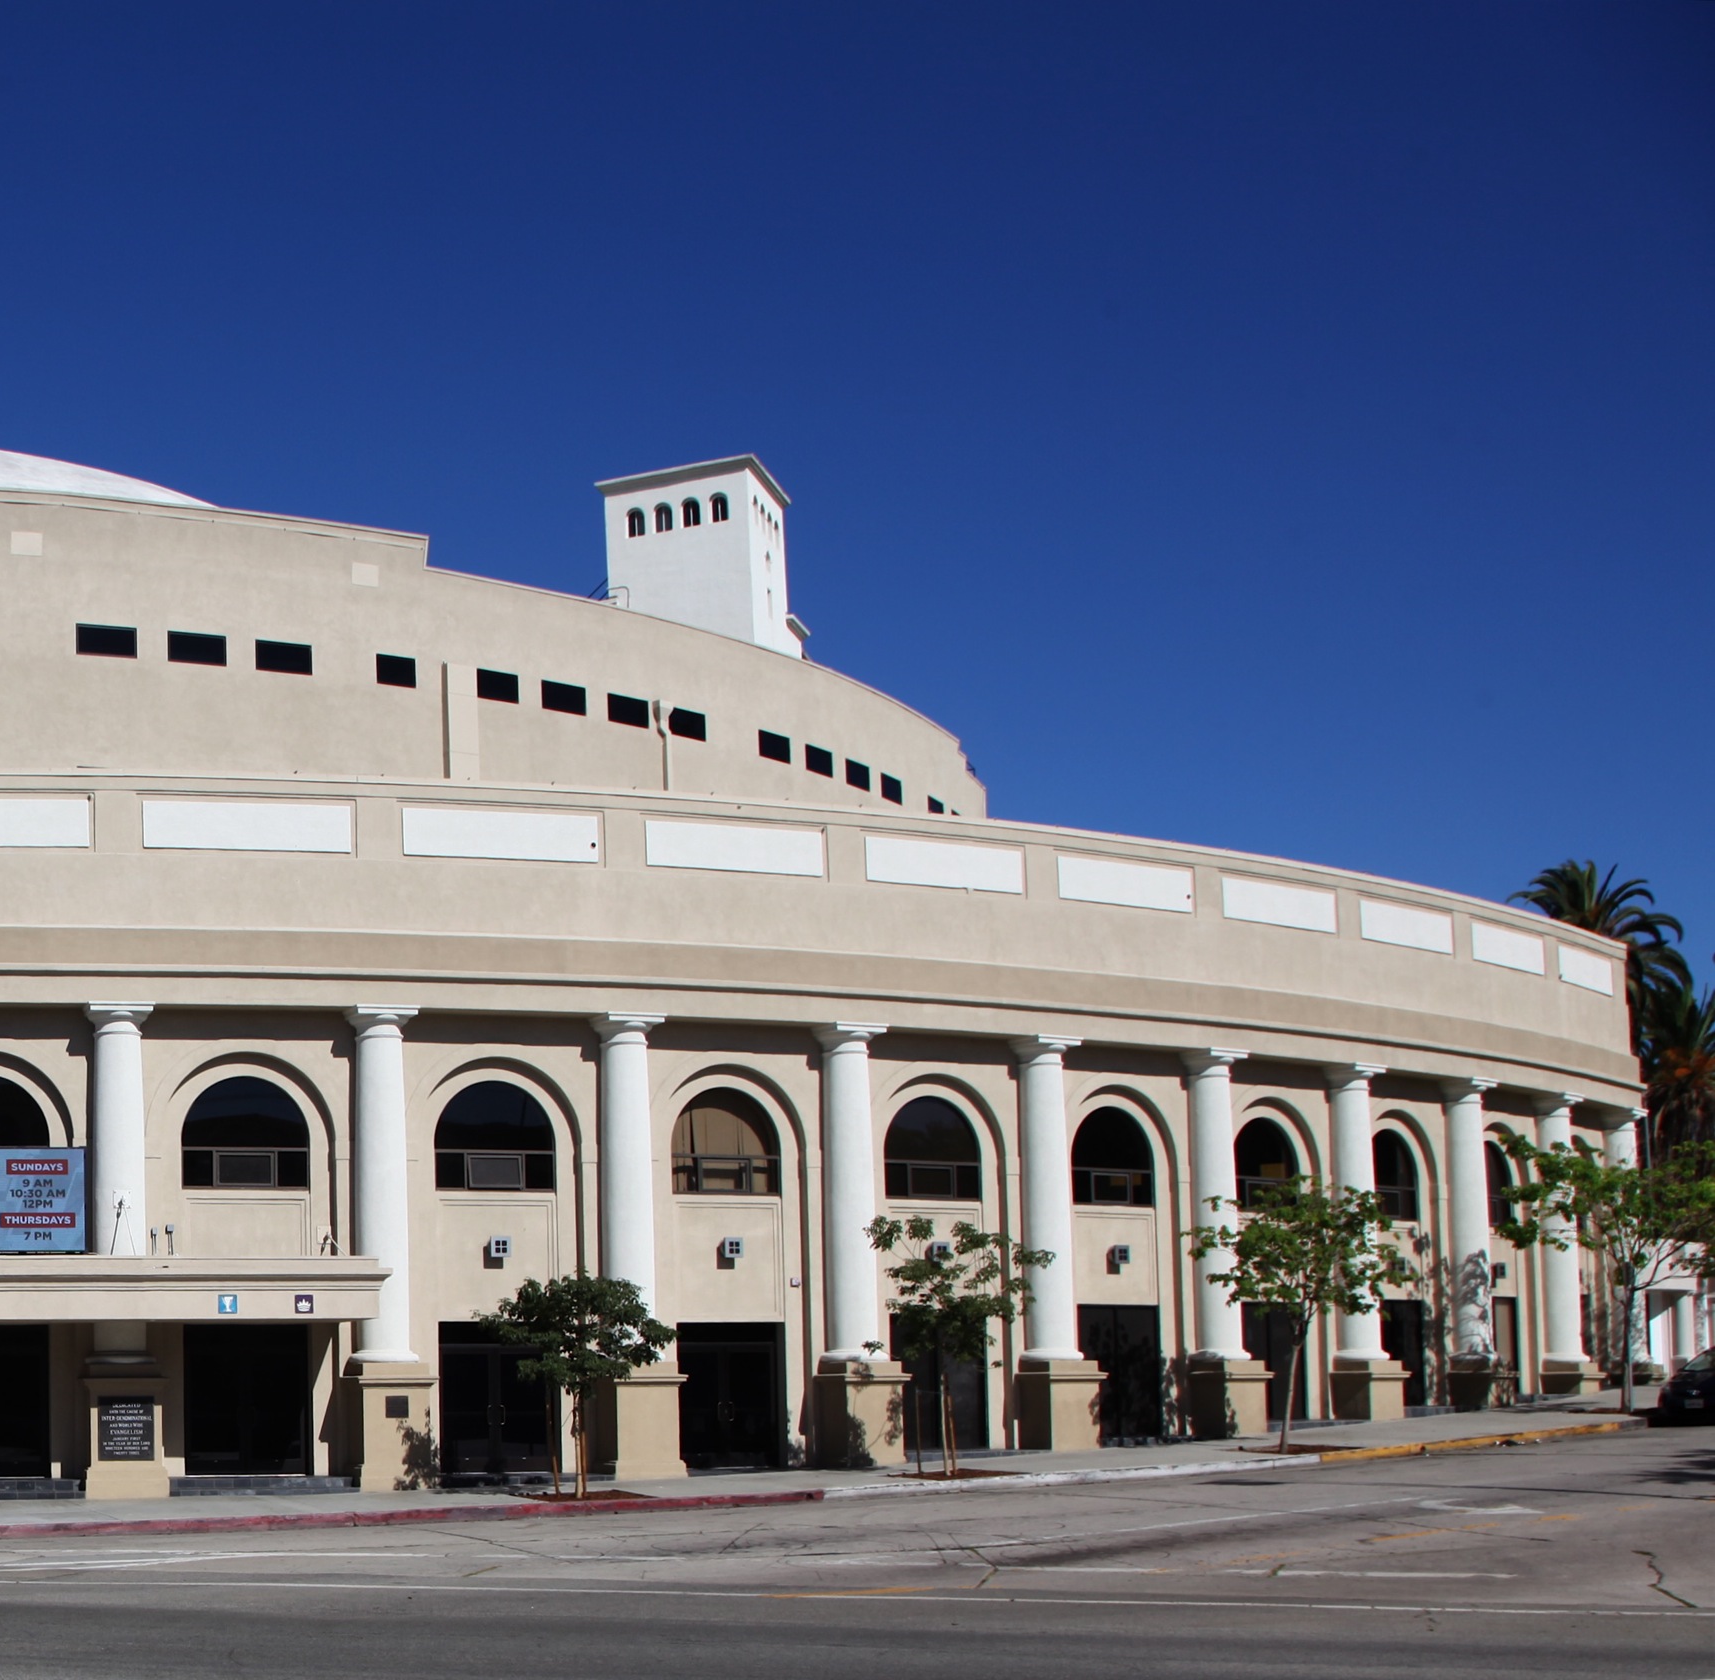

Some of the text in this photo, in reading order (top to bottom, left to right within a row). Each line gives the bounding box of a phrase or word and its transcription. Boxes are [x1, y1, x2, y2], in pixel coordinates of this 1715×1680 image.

[11, 1163, 64, 1171] SUNDAYS
[22, 1179, 53, 1187] 9 AM
[10, 1189, 66, 1198] 10:30 AM
[22, 1199, 53, 1209] 12PM
[4, 1215, 71, 1225] THURSDAYS
[23, 1231, 53, 1240] 7 PM
